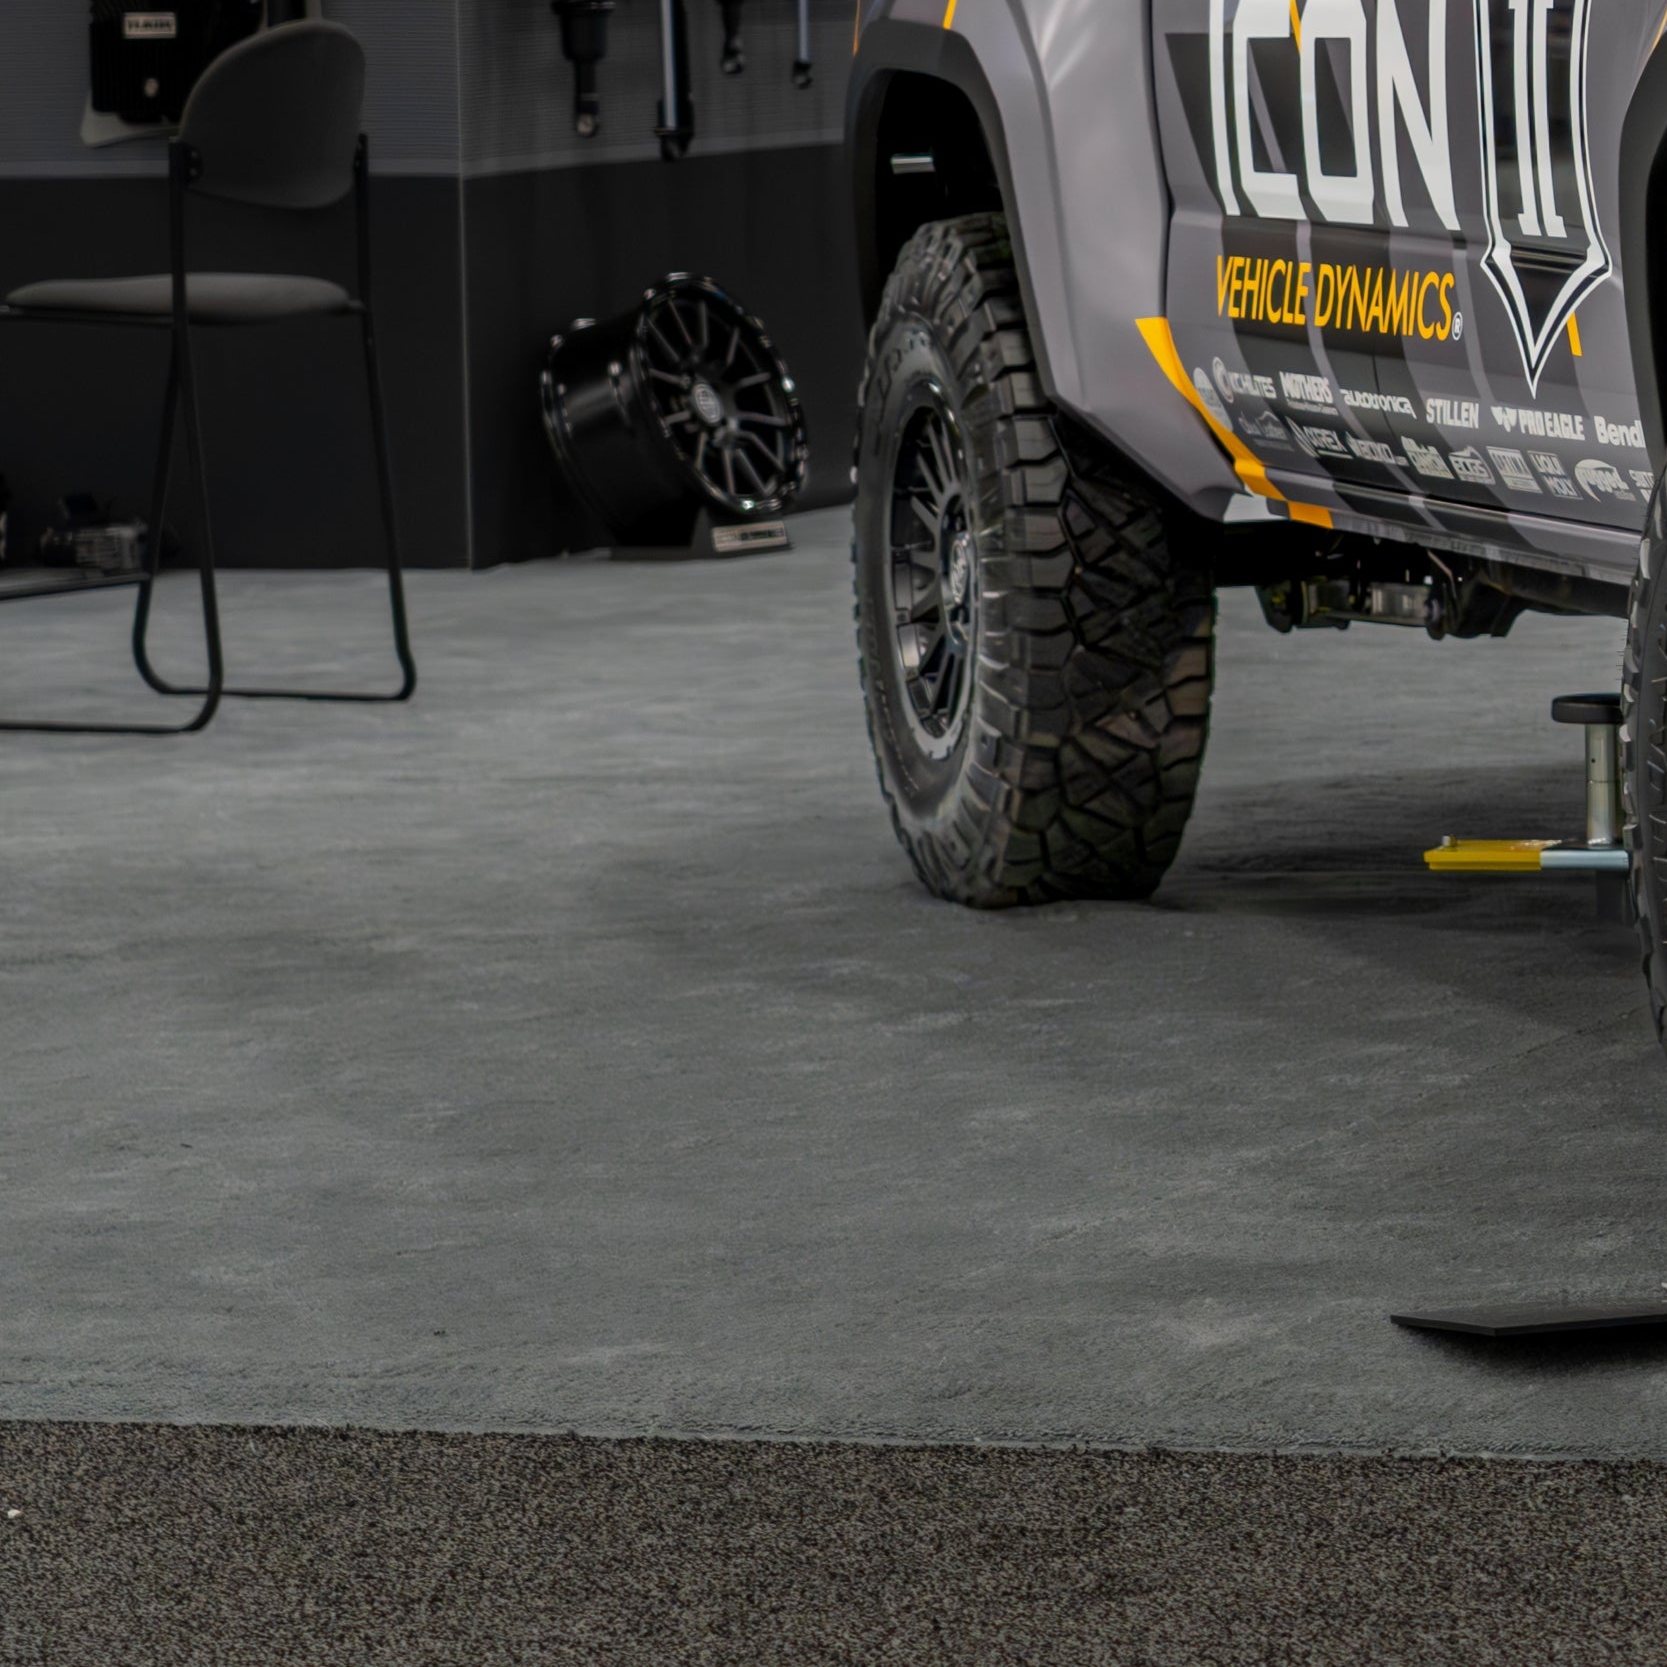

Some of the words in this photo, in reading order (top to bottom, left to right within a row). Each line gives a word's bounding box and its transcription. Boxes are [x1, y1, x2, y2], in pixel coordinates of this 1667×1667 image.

[1217, 254, 1310, 327] VEHICLE
[1279, 371, 1335, 403] MOTHERS
[1426, 398, 1480, 429] STILLEN
[1544, 412, 1586, 441] EAGLE
